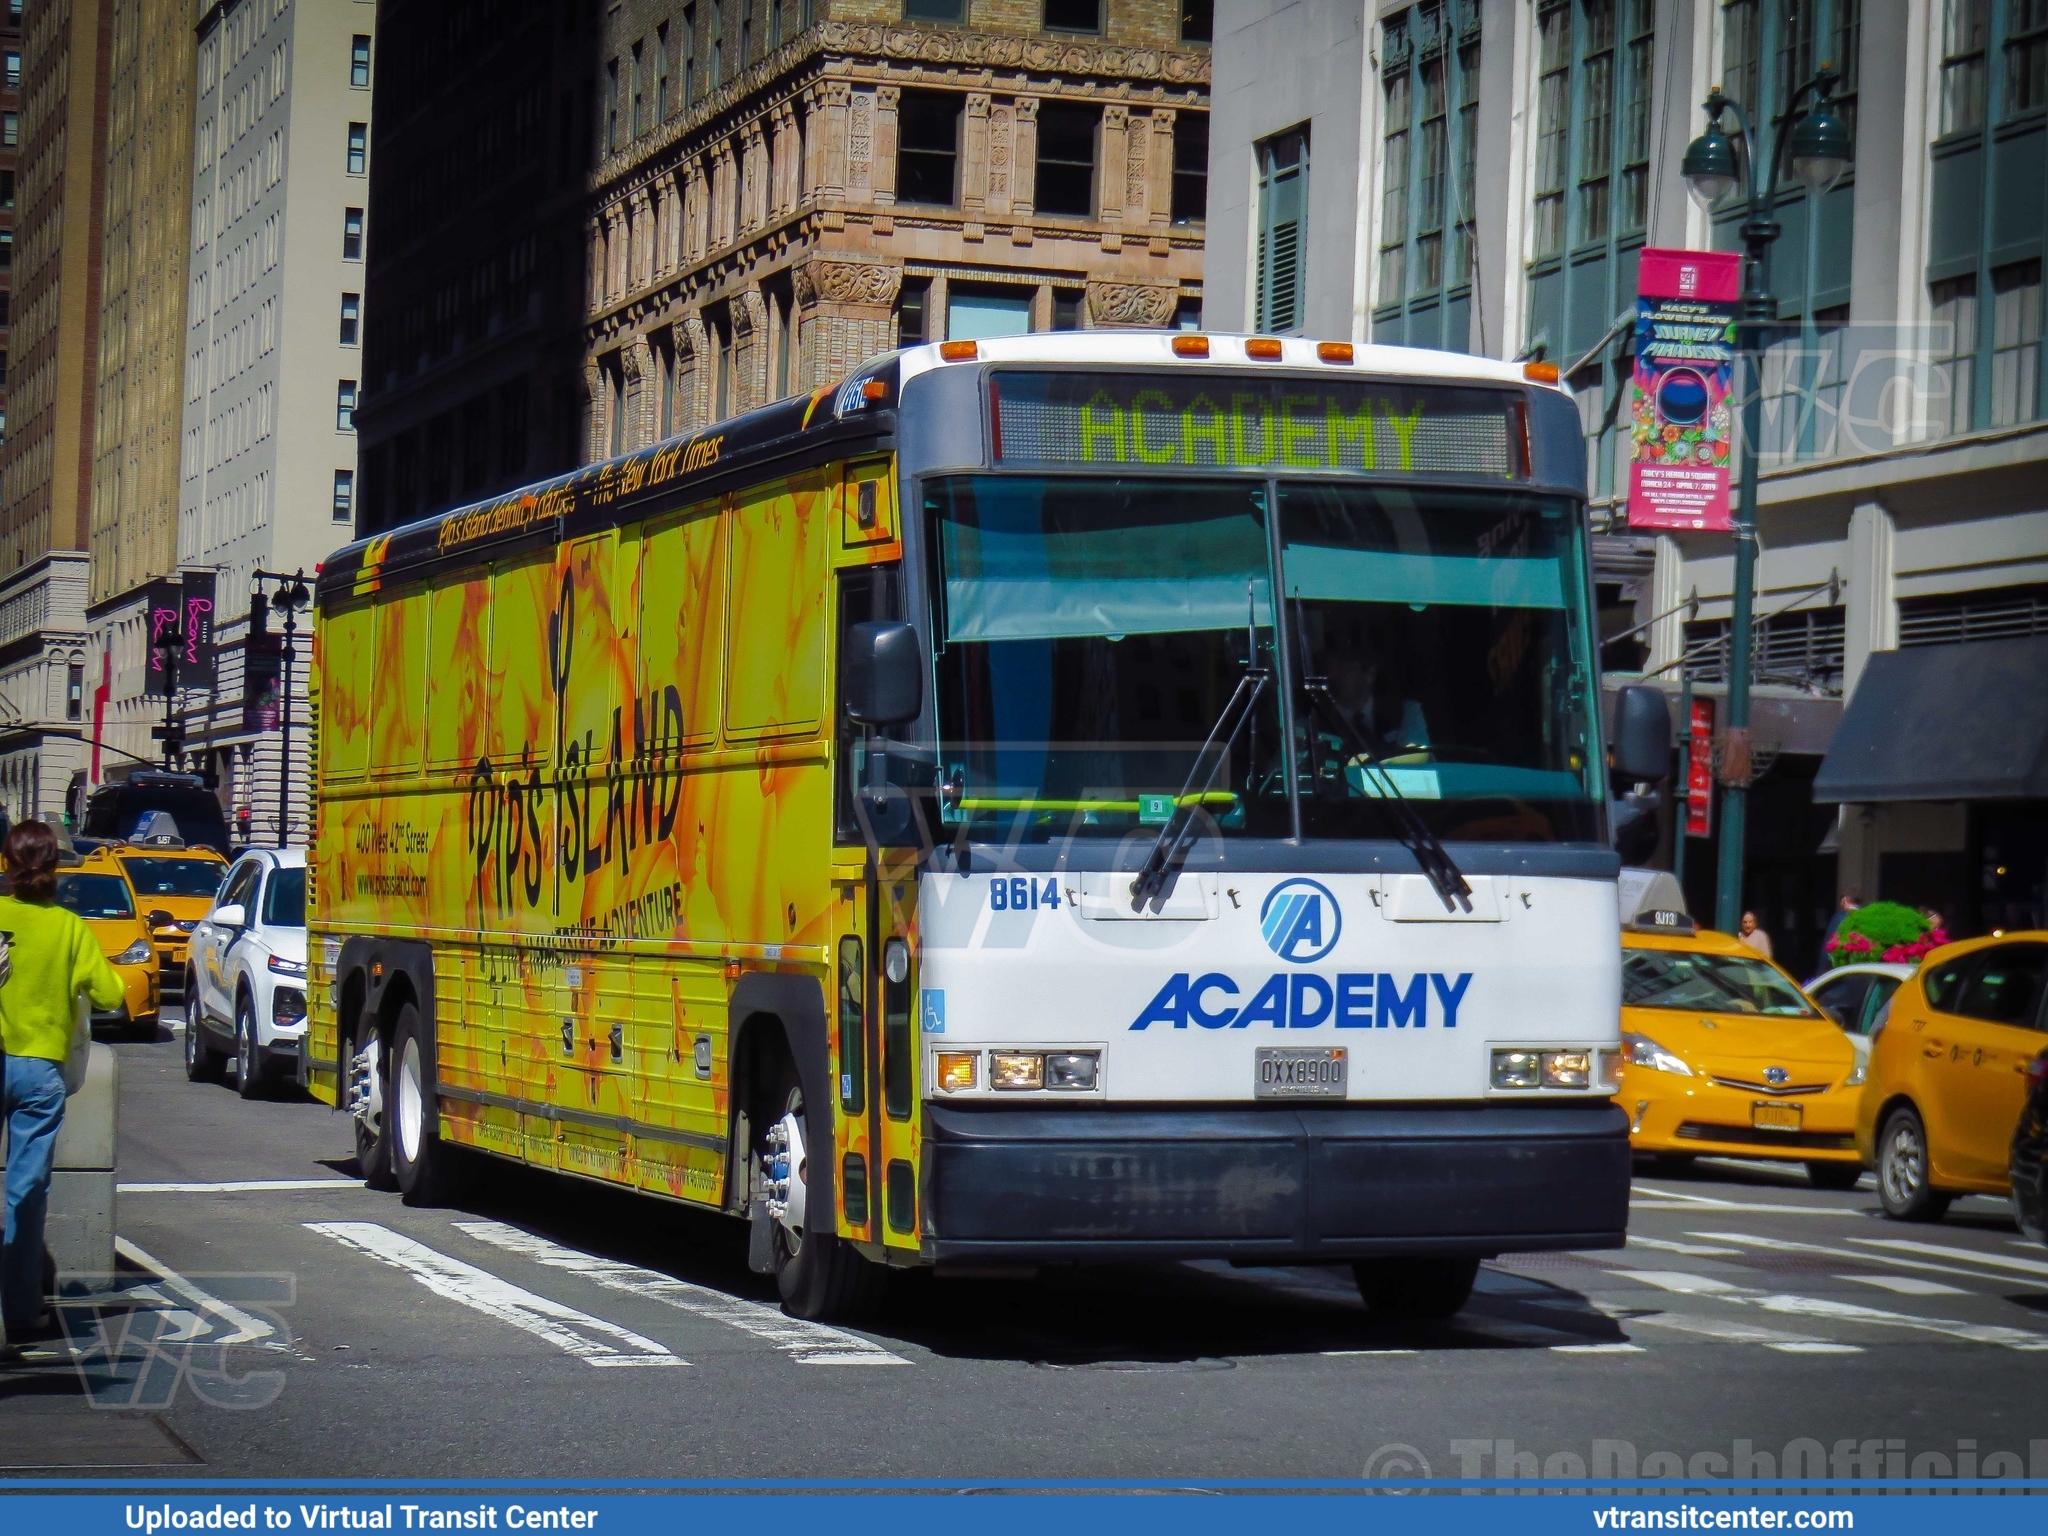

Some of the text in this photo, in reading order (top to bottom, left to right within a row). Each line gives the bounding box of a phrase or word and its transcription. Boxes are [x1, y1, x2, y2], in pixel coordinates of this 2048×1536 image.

[1640, 312, 1733, 324] FLOWER SHOW
[1660, 304, 1708, 314] MACY'S
[1653, 324, 1722, 342] JOURNEY
[1080, 389, 1425, 471] ACADEMY
[647, 437, 686, 486] York
[680, 431, 724, 476] Times
[549, 566, 685, 917] ISLAND
[356, 822, 371, 854] 400
[372, 822, 388, 853] West
[406, 822, 429, 853] Street
[990, 877, 1061, 911] 8614
[600, 881, 684, 951] ADVENTURE
[1655, 911, 1676, 925] 9J13
[1128, 972, 1474, 1031] ACADEMY
